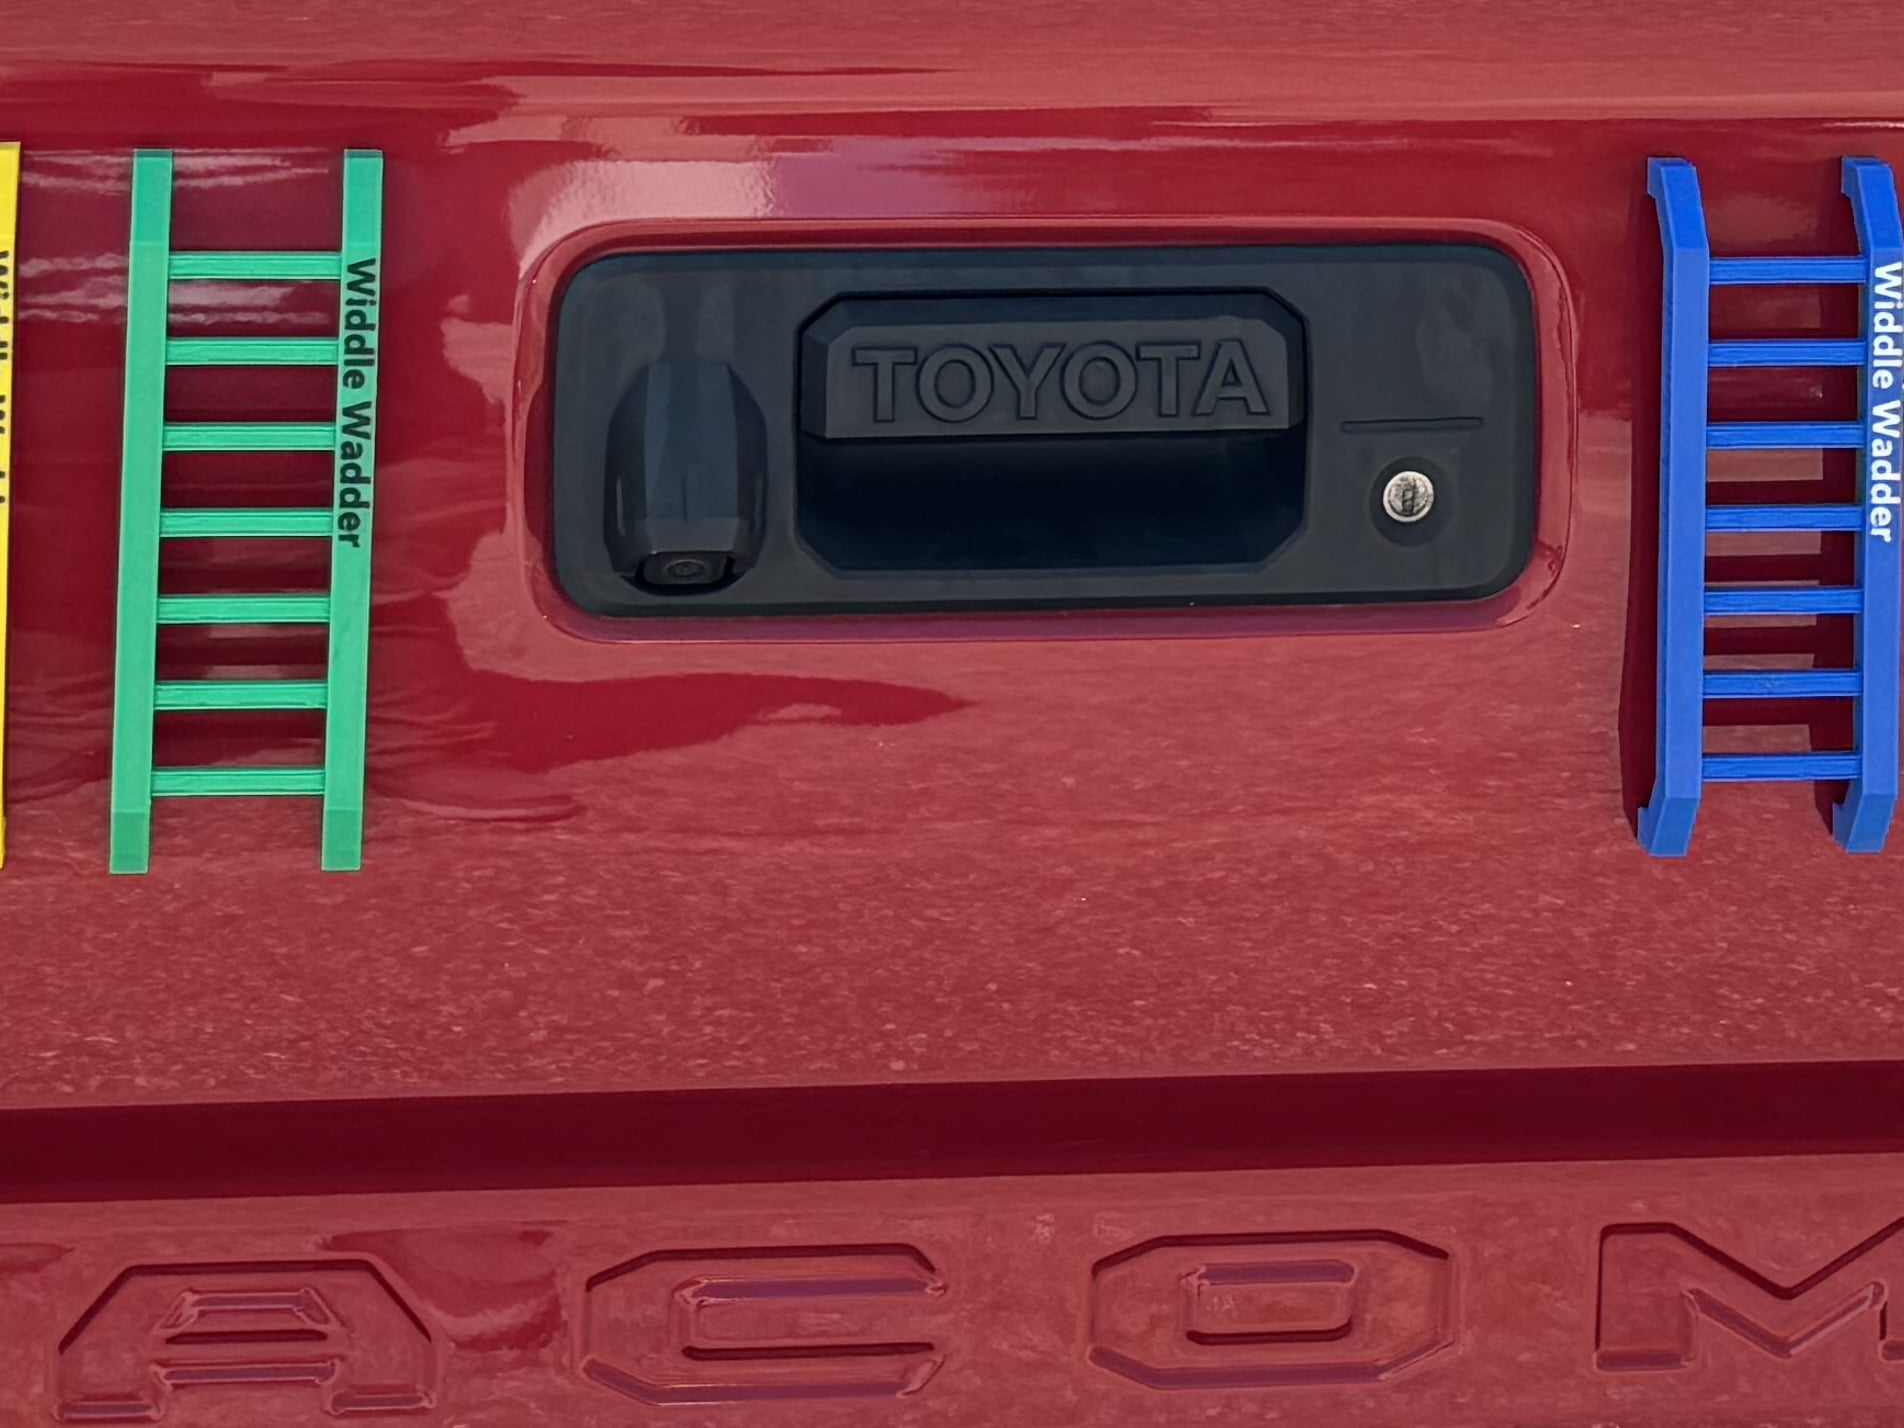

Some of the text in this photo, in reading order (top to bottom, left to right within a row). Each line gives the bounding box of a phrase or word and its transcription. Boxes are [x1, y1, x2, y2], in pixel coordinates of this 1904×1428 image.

[337, 257, 377, 548] Widdle Wadder
[852, 337, 1273, 425] TOYOTA
[1870, 261, 1904, 543] Widdle Wadder
